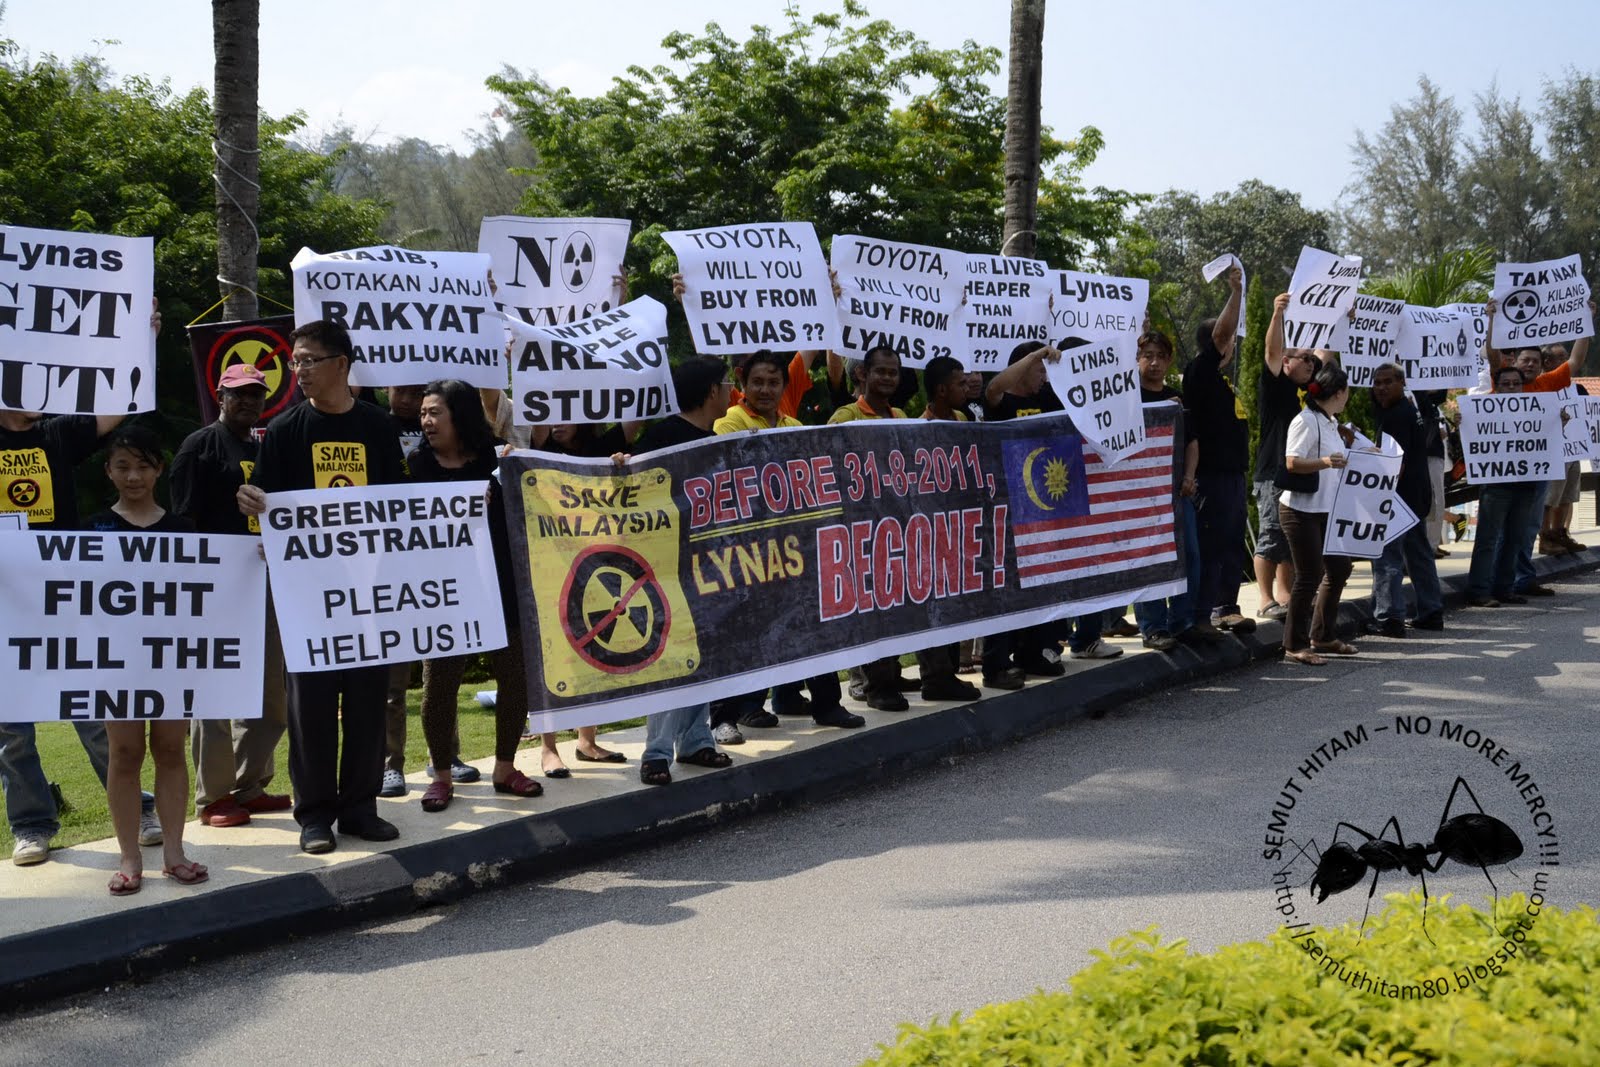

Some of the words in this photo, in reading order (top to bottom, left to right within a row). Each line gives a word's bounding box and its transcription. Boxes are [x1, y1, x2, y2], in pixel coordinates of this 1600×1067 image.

[0, 232, 123, 271] Lynas
[686, 228, 801, 252] TOYOTA,
[329, 248, 438, 268] NAJIB,
[706, 261, 757, 279] WILL
[760, 261, 802, 279] YOU
[855, 241, 948, 279] TOYOTA,
[966, 260, 987, 274] UR
[991, 258, 1045, 277] LIVES
[1328, 260, 1360, 279] Lynas
[306, 271, 421, 293] KOTAKAN
[428, 277, 488, 297] JANJI
[1509, 269, 1549, 286] TAK
[1551, 263, 1577, 282] NAK
[701, 290, 747, 309] BUY
[756, 289, 817, 308] FROM
[854, 277, 901, 296] WILL
[903, 283, 940, 303] YOU
[1059, 273, 1133, 302] Lynas
[1300, 283, 1350, 308] GET
[1547, 284, 1585, 302] KILANG
[321, 301, 485, 334] RAKYAT
[850, 298, 893, 320] BUY
[900, 306, 949, 331] FROM
[973, 304, 1012, 317] THAN
[1354, 296, 1404, 316] KUANTAN
[1538, 297, 1584, 317] KANSER
[542, 309, 631, 339] NTAN
[702, 319, 796, 345] LYNAS
[802, 323, 824, 341] ??
[1051, 309, 1089, 328] YOU
[1095, 314, 1126, 331] ARE
[1128, 316, 1137, 332] A
[1349, 317, 1389, 333] PEOPLE
[1508, 326, 1520, 340] di
[1524, 318, 1584, 338] Gebeng
[842, 325, 926, 360] LYNAS
[1342, 336, 1363, 355] RE
[974, 350, 998, 363] ???
[1071, 347, 1119, 374] LYNAS,
[1091, 370, 1136, 402] BACK
[523, 384, 671, 422] STUPID!
[1471, 396, 1546, 414] TOYOTA,
[1094, 410, 1112, 430] TO
[1477, 422, 1509, 435] WILL
[1513, 420, 1542, 433] YOU
[2, 451, 40, 467] SAVE
[321, 446, 359, 461] SAVE
[1469, 441, 1501, 454] BUY
[1506, 439, 1547, 453] FROM
[316, 463, 365, 473] MALAYSIA
[1470, 460, 1528, 478] LYNAS
[559, 484, 640, 509] SAVE
[683, 455, 842, 529] BEFORE
[843, 444, 996, 501] 31-8-2011,
[268, 495, 484, 531] GREENPEACE
[537, 509, 672, 537] MALAYSIA
[36, 535, 103, 561] WE
[118, 536, 220, 564] WILL
[283, 523, 473, 561] AUSTRALIA
[692, 535, 805, 595] LYNAS
[816, 507, 983, 623] BEGONE
[45, 580, 214, 616] FIGHT
[323, 579, 459, 618] PLEASE
[8, 637, 125, 670] TILL
[142, 637, 240, 669] THE
[306, 630, 400, 666] HELP
[412, 624, 454, 654] US
[60, 690, 164, 719] END
